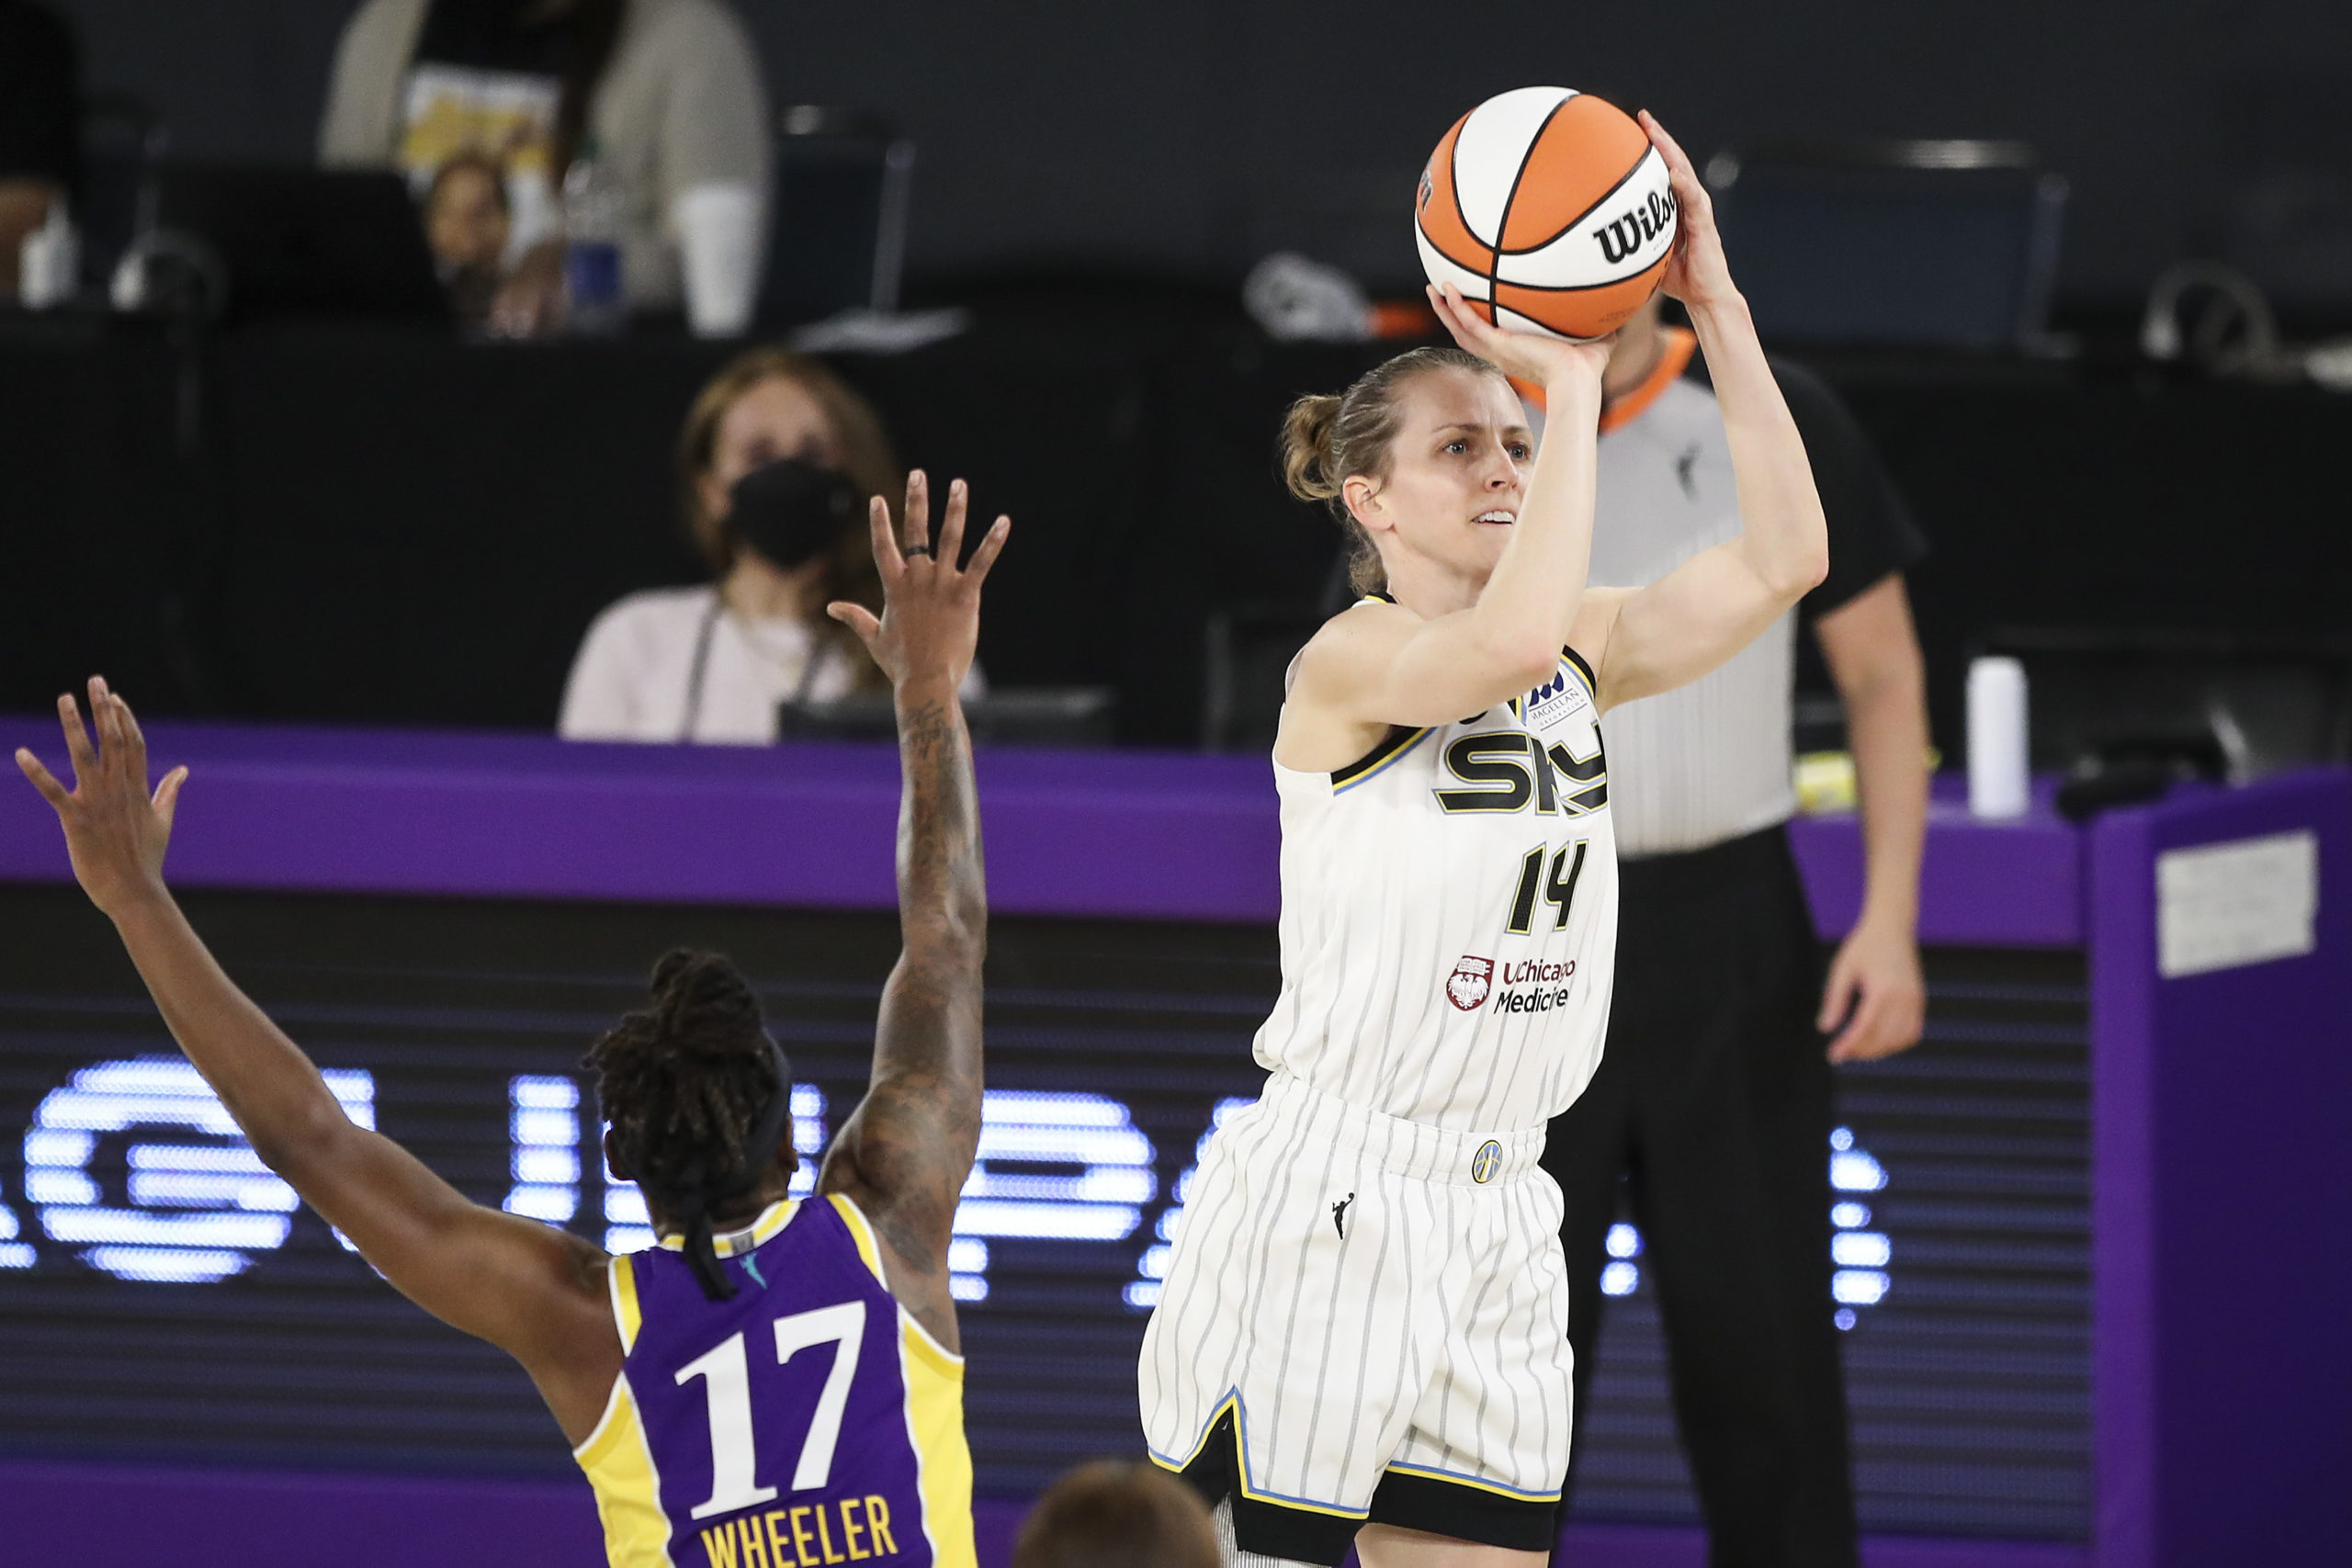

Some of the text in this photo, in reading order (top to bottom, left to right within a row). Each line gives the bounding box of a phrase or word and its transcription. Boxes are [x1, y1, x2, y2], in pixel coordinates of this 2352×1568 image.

[1592, 188, 1675, 264] Wilso
[1504, 839, 1589, 936] 14
[673, 1300, 866, 1520] 17
[700, 1495, 899, 1568] WHEELER
